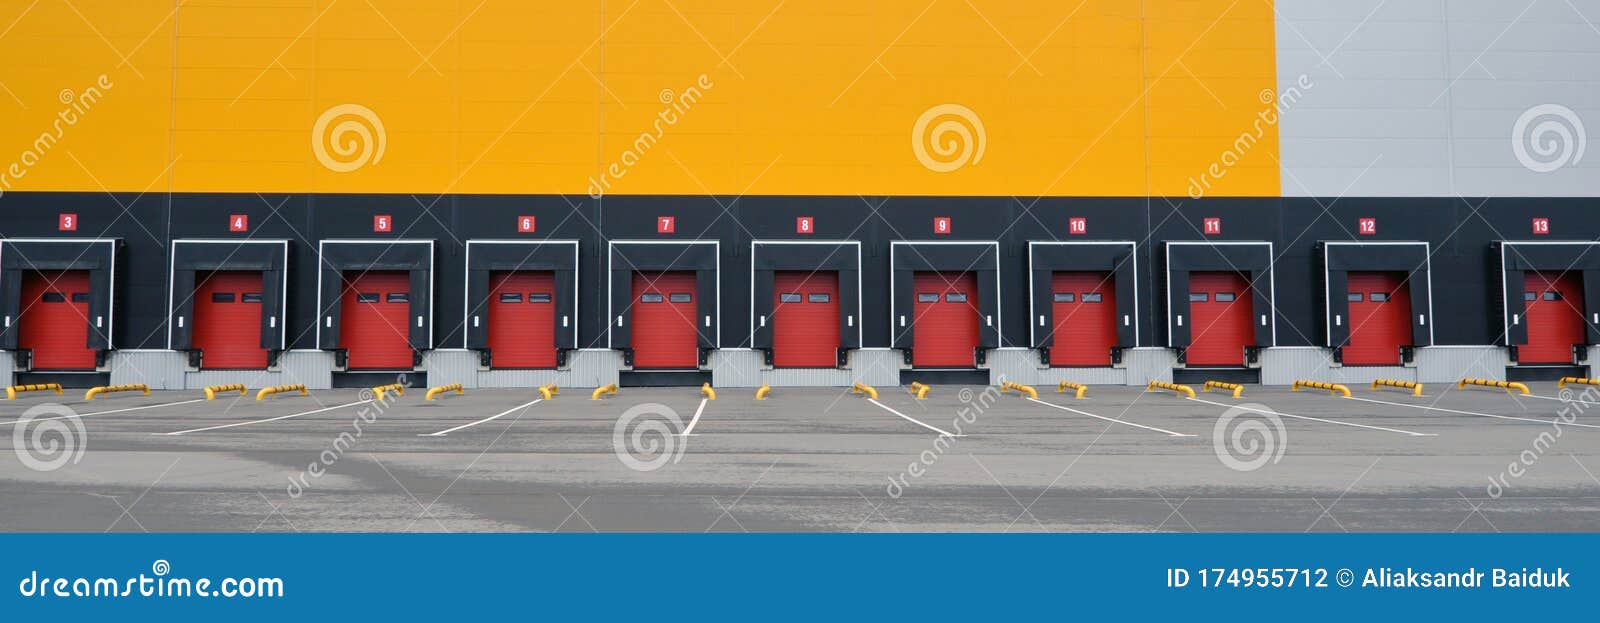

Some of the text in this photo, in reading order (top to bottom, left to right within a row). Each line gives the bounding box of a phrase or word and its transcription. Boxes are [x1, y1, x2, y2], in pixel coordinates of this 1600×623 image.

[64, 216, 72, 228] 3
[234, 217, 243, 229] 4
[378, 217, 387, 230] 5
[522, 218, 531, 230] 6
[662, 219, 670, 231] 7
[801, 219, 809, 232] 8
[938, 219, 946, 232] 9
[1071, 220, 1084, 232] 10
[1205, 220, 1218, 232] 11
[1362, 220, 1375, 232] 12
[1534, 220, 1547, 232] 13
